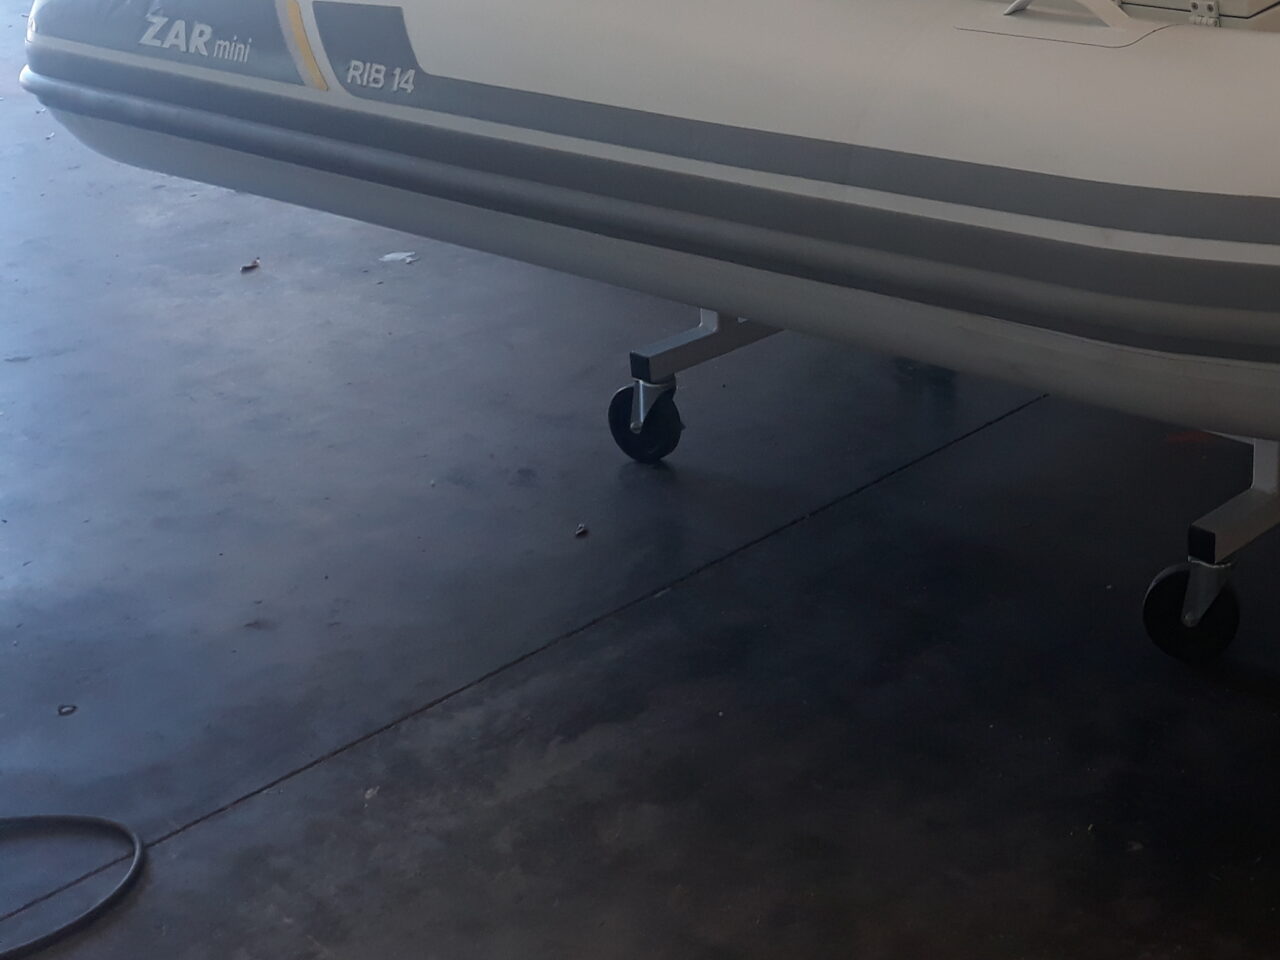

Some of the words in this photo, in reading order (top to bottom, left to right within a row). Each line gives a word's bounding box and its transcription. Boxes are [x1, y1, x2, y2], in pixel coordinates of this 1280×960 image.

[138, 14, 213, 56] ZAR
[213, 36, 252, 63] mini
[347, 59, 386, 89] RIB
[391, 66, 416, 93] 14
